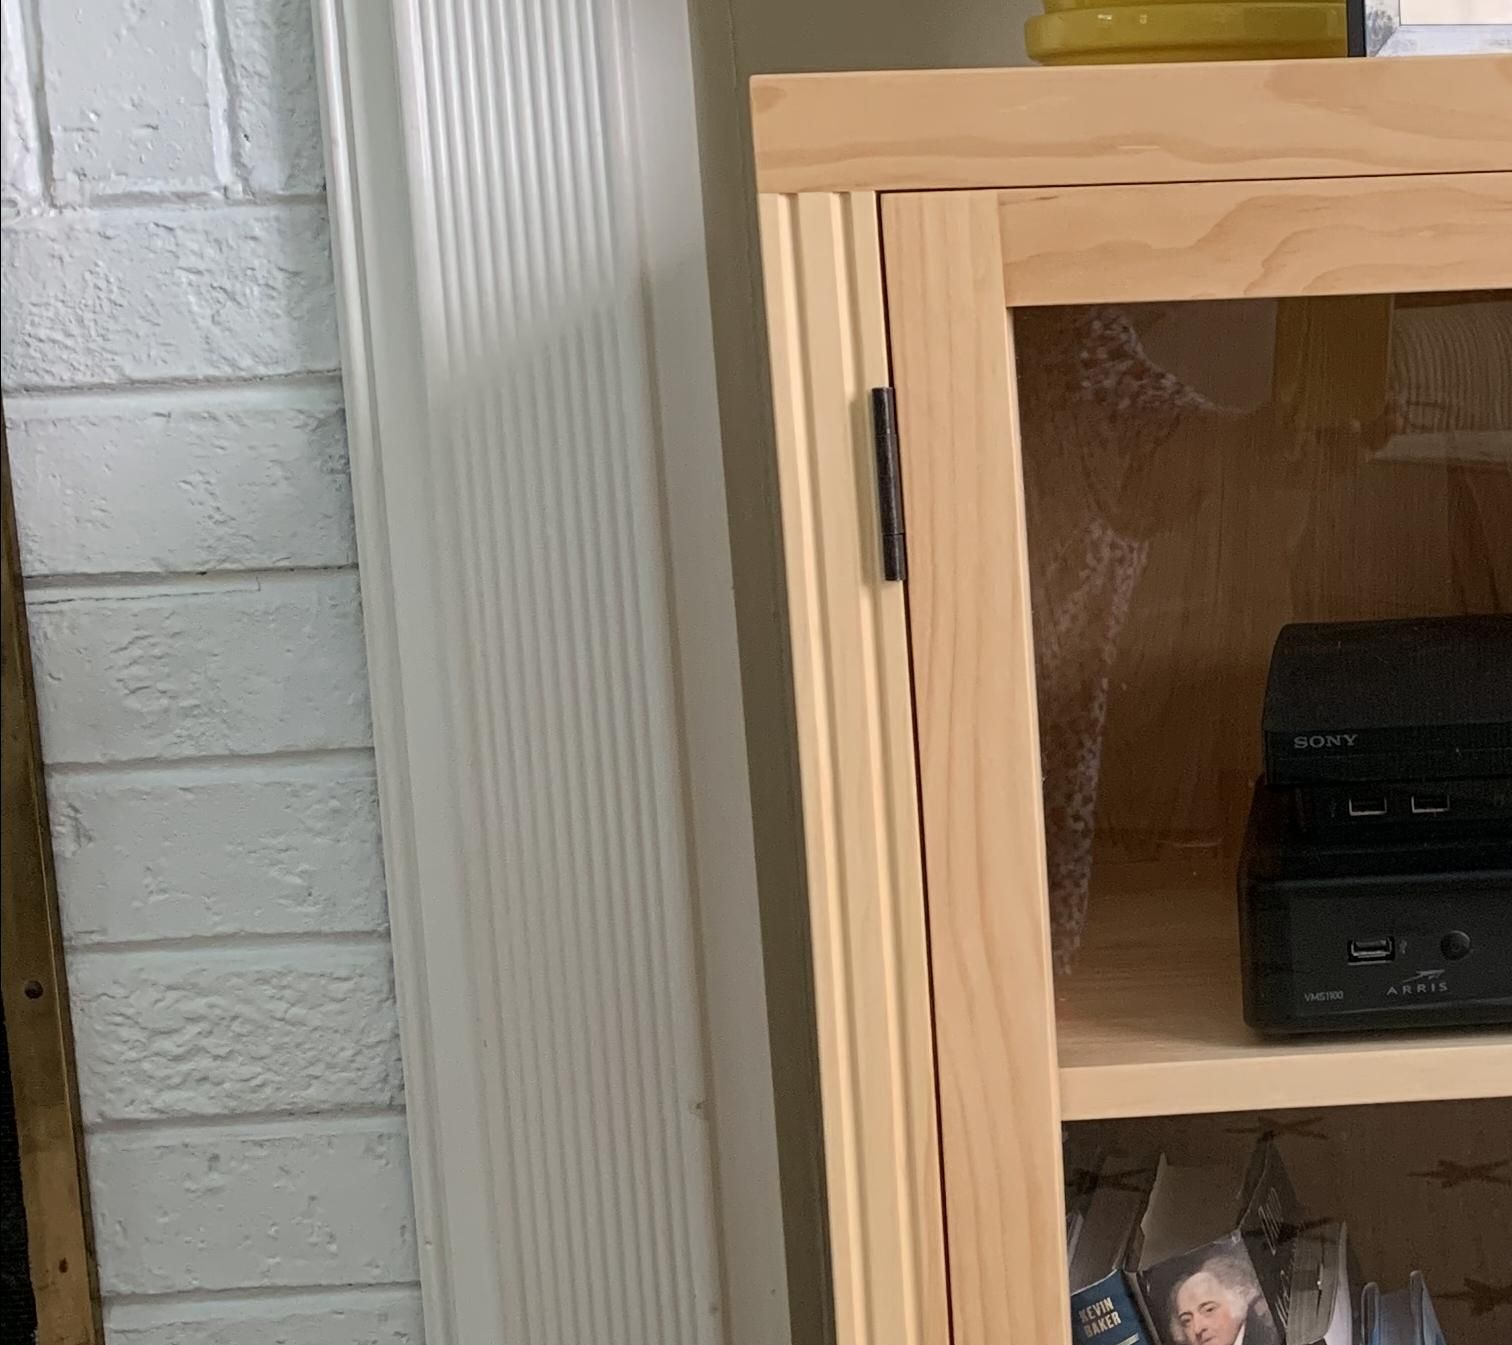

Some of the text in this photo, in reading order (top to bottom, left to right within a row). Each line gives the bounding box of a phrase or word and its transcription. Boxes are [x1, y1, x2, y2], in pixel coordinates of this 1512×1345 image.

[1293, 733, 1359, 750] SONY
[1385, 981, 1449, 997] ARRIS
[1077, 1296, 1115, 1324] KEVIN
[1082, 1310, 1123, 1339] BAKER
